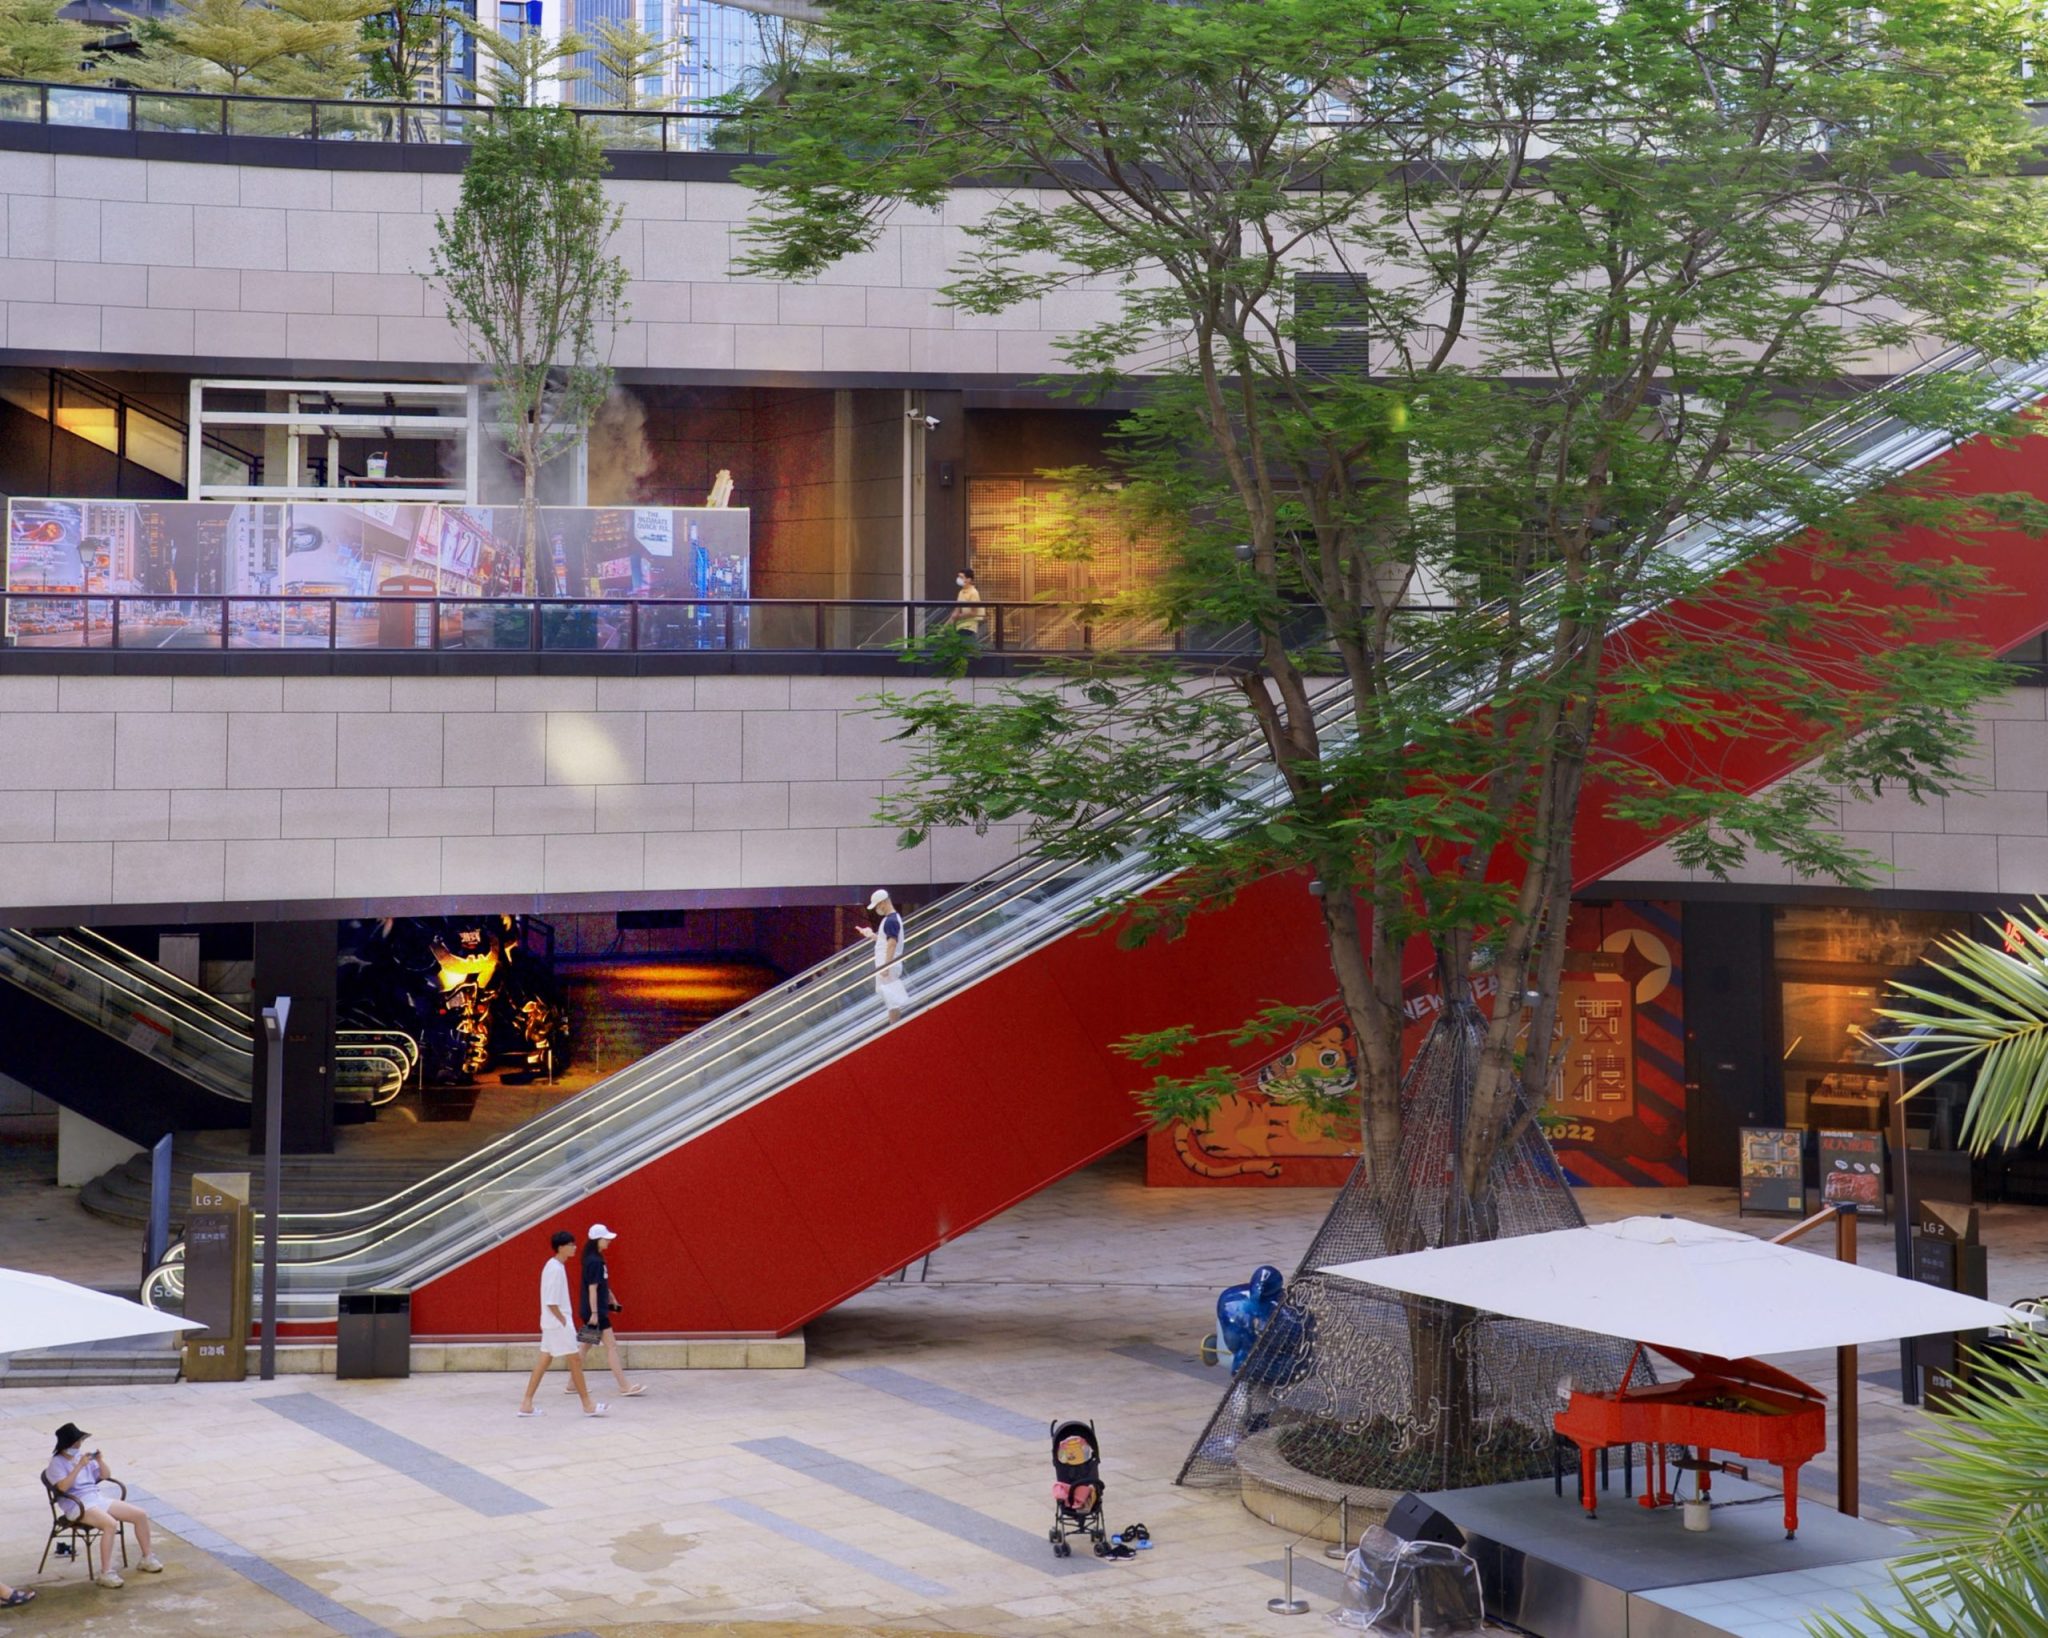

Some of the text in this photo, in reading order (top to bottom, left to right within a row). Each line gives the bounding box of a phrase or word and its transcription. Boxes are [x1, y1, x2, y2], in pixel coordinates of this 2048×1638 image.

[195, 1195, 223, 1206] LG 2
[1923, 1221, 1945, 1236] LG 2
